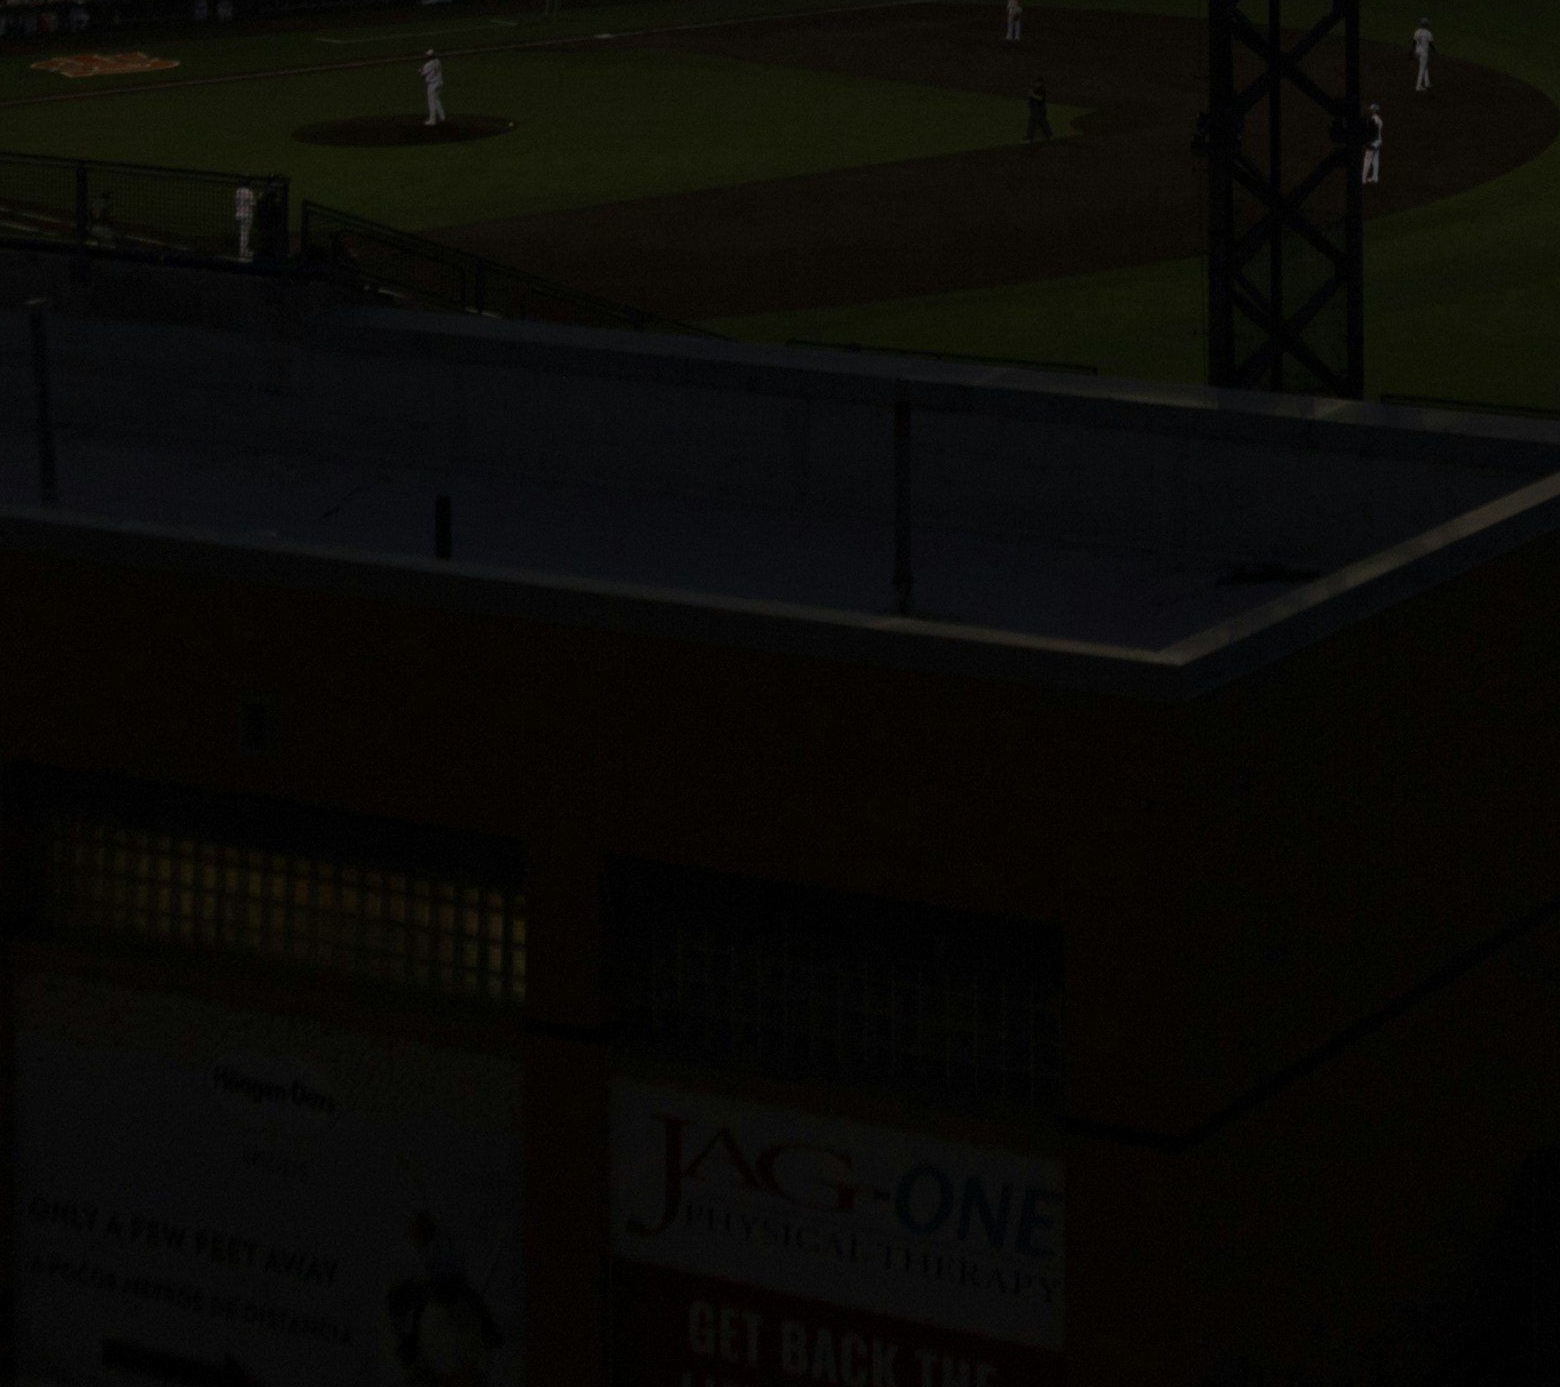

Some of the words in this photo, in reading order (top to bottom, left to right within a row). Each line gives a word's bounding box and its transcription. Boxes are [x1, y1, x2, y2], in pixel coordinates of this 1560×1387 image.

[627, 1109, 1064, 1256] JAG-ONE
[28, 1193, 97, 1234] ONLY
[106, 1211, 122, 1236] A
[131, 1217, 186, 1249] FEW
[195, 1228, 260, 1269] FEET
[265, 1244, 340, 1286] AWAY
[685, 1202, 869, 1261] PHYSICAL
[877, 1242, 1063, 1304] THERAPY
[243, 1300, 354, 1346] DISTANCIA
[687, 1299, 764, 1368] GET
[780, 1318, 899, 1387] BACK
